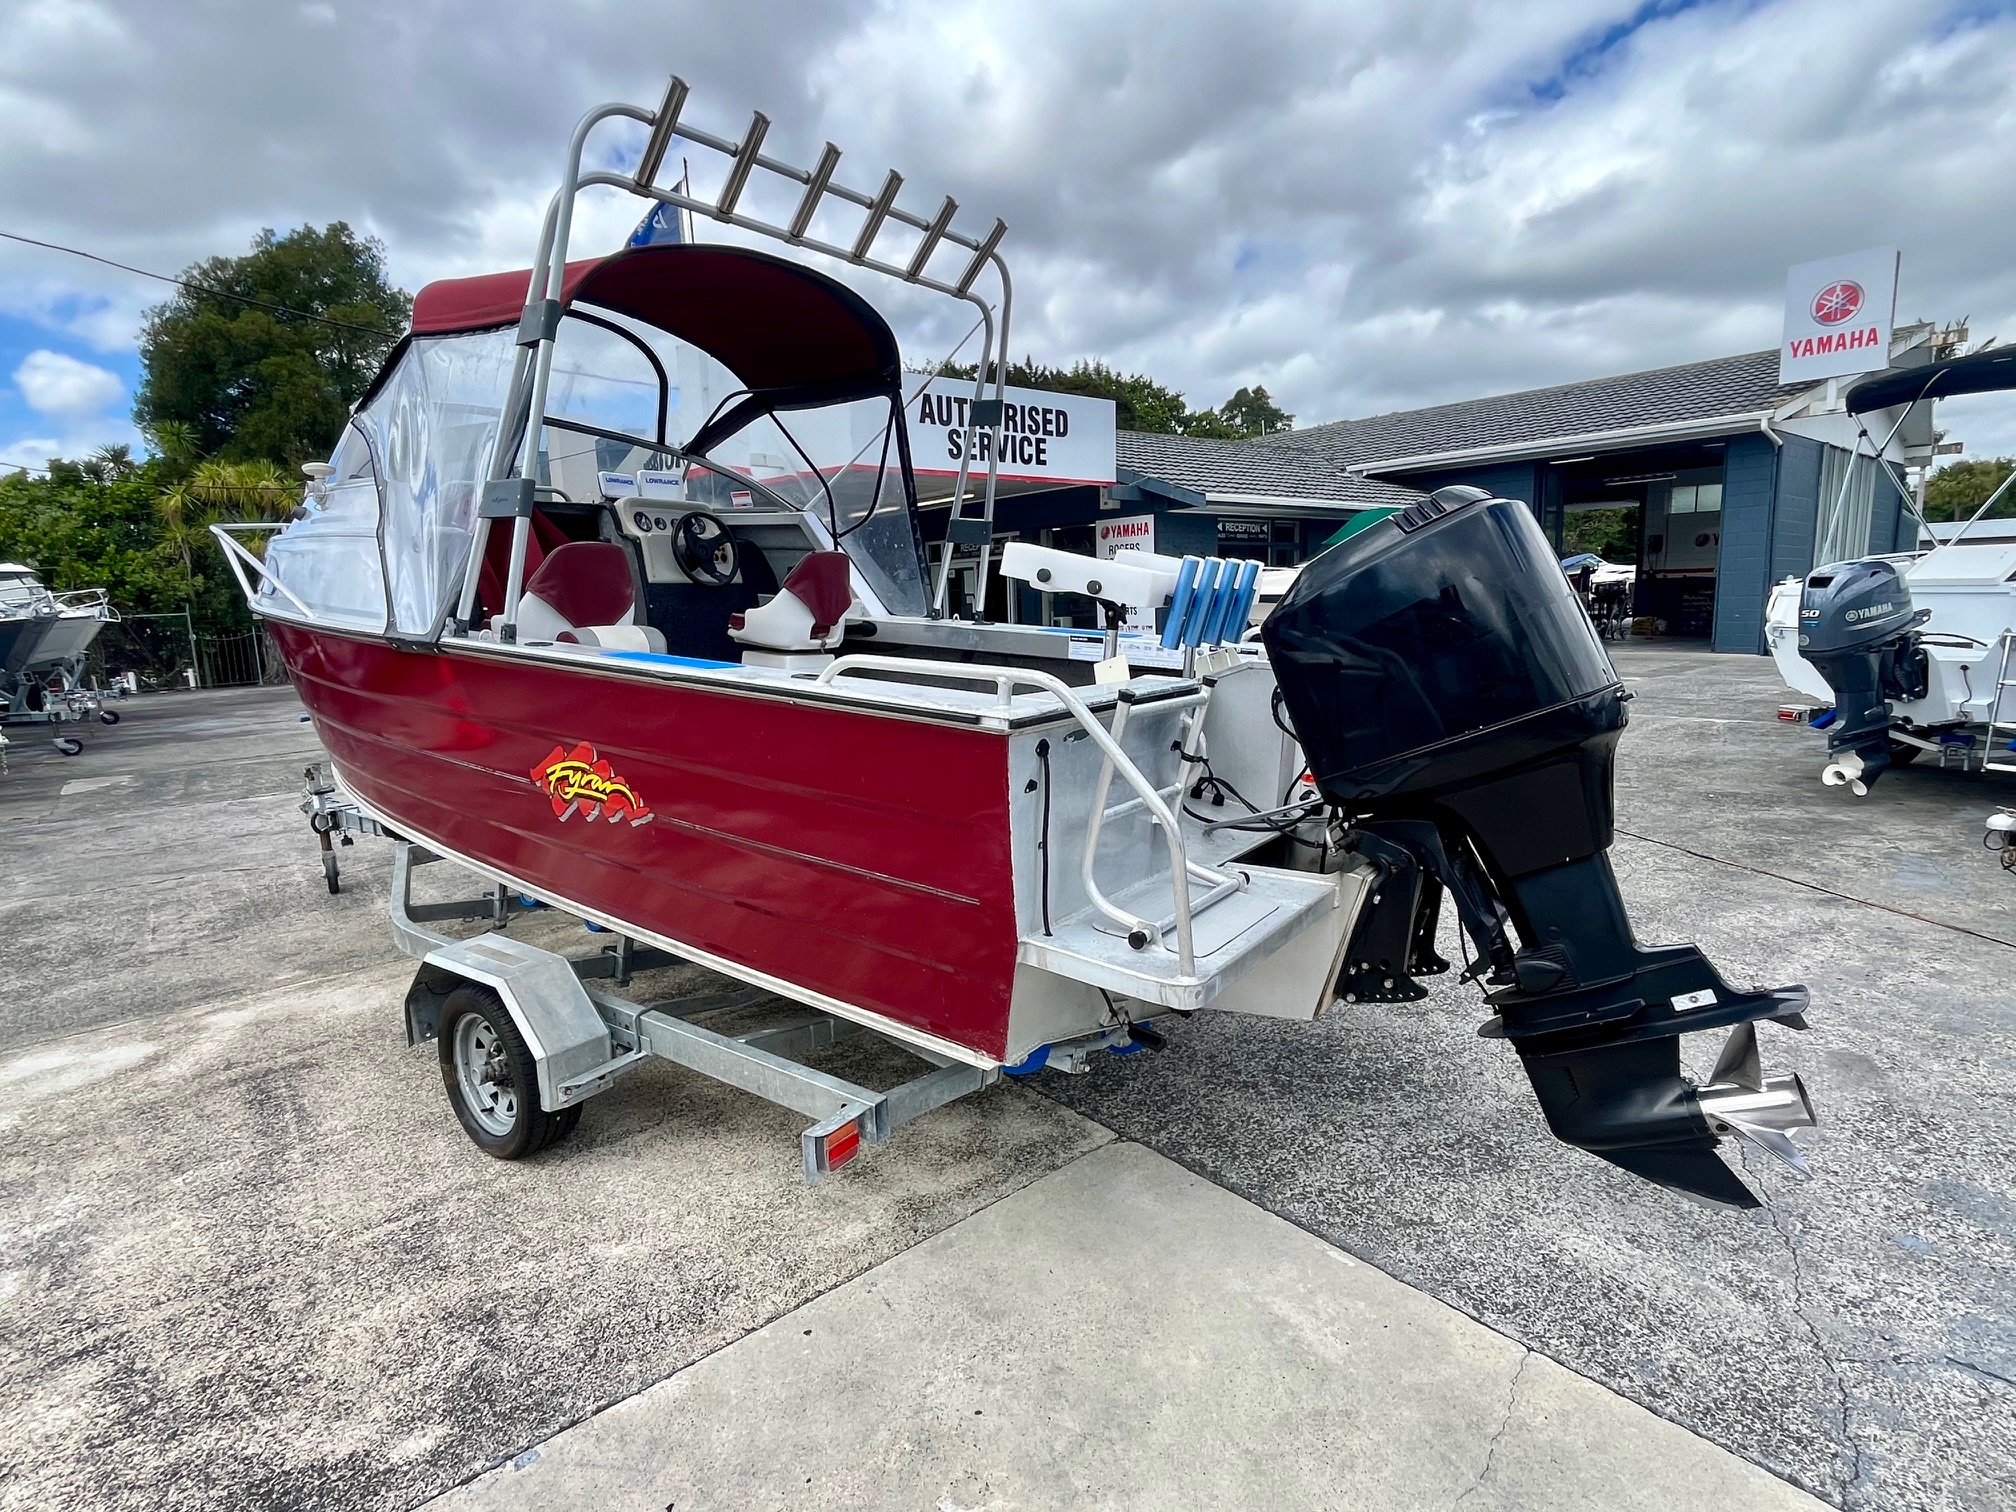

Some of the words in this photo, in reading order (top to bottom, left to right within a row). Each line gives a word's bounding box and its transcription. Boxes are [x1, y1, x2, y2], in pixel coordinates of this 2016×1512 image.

[1790, 327, 1879, 358] YAMAHA
[919, 393, 1069, 438] AUTRISED
[947, 429, 1048, 466] SERVICE
[605, 477, 634, 486] LOWRANCE
[645, 477, 680, 486] LOWRANCE
[1110, 521, 1150, 539] YAMAHA
[1225, 522, 1261, 533] RECEPTION
[1801, 609, 1820, 618] 50
[1857, 601, 1894, 619] YAMAHA
[545, 760, 638, 811] Fyran
